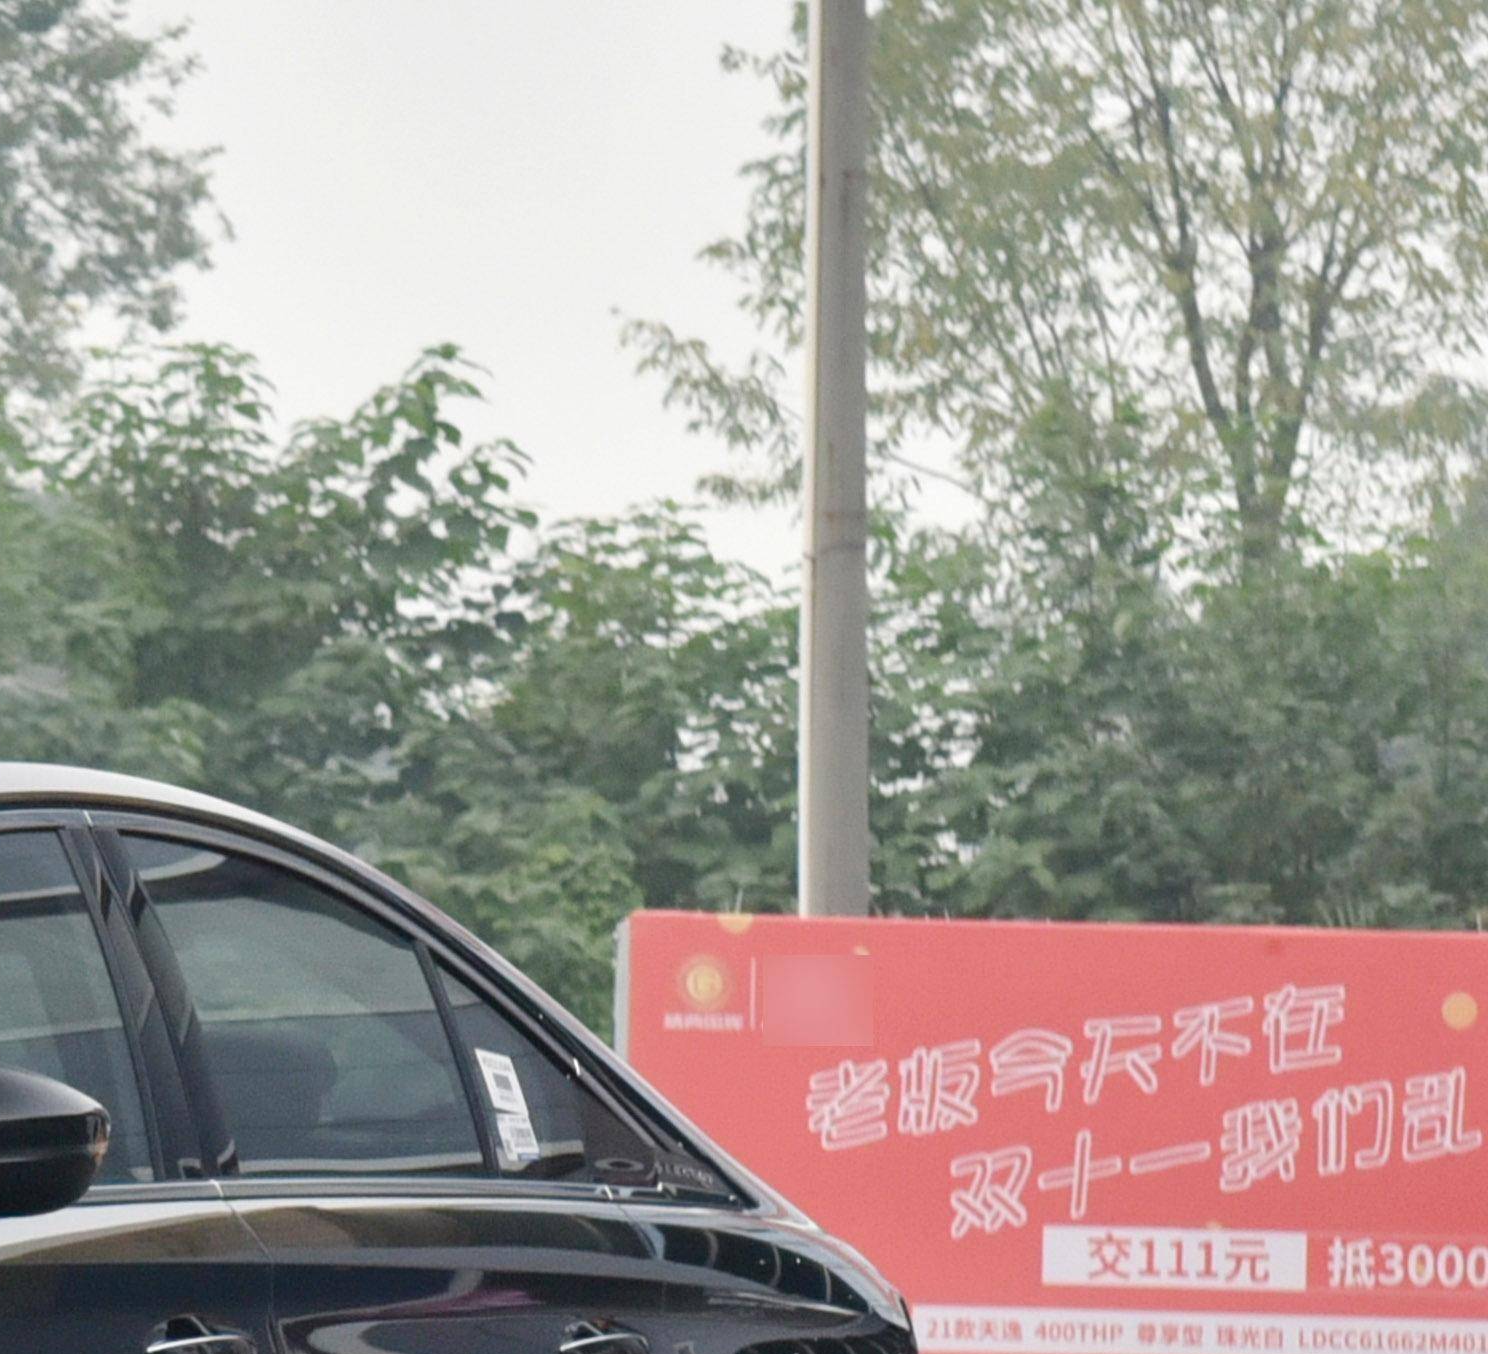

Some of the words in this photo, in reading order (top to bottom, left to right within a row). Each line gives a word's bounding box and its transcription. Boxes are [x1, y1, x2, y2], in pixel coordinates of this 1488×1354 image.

[806, 984, 1346, 1152] 老板今天不在
[949, 1066, 1483, 1241] 双十一我们乱
[1087, 1232, 1271, 1283] 交111元
[1035, 1320, 1124, 1343] 400THP
